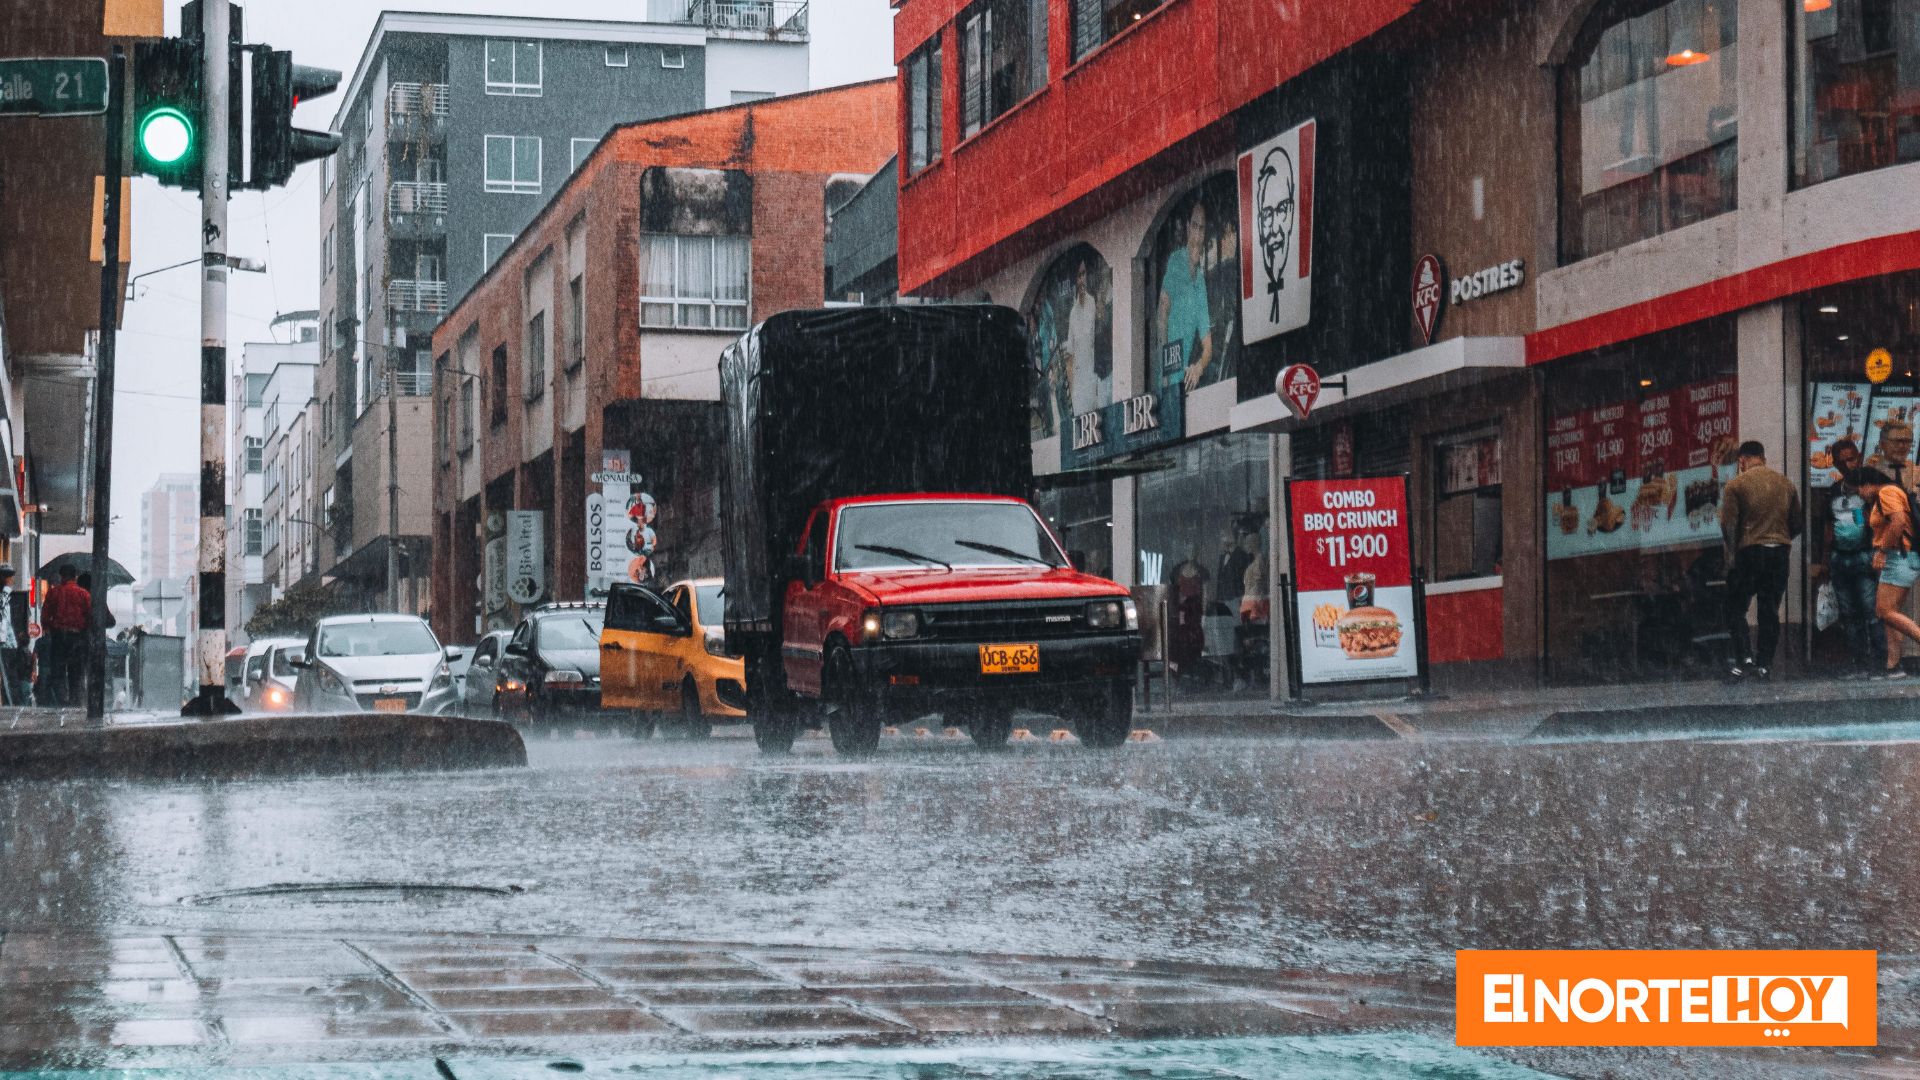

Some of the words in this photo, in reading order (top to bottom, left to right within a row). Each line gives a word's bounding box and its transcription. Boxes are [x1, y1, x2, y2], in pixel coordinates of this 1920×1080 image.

[0, 74, 33, 100] alle
[56, 72, 82, 99] 21
[1451, 259, 1523, 305] POSTRES
[1415, 284, 1439, 309] KFC
[1164, 344, 1182, 366] LBR
[1289, 382, 1317, 396] KFC
[1122, 393, 1158, 436] LBR
[1698, 399, 1726, 416] AHORRO
[1071, 411, 1101, 451] LBR
[1603, 423, 1615, 436] KFC
[595, 473, 639, 484] MONALISA
[1323, 490, 1375, 509] COMBO
[1304, 512, 1335, 532] BBQ
[1337, 509, 1397, 529] CRUNCH
[518, 515, 532, 576] BioVital
[590, 503, 602, 571] BOLSOS
[1316, 533, 1388, 567] $11.900
